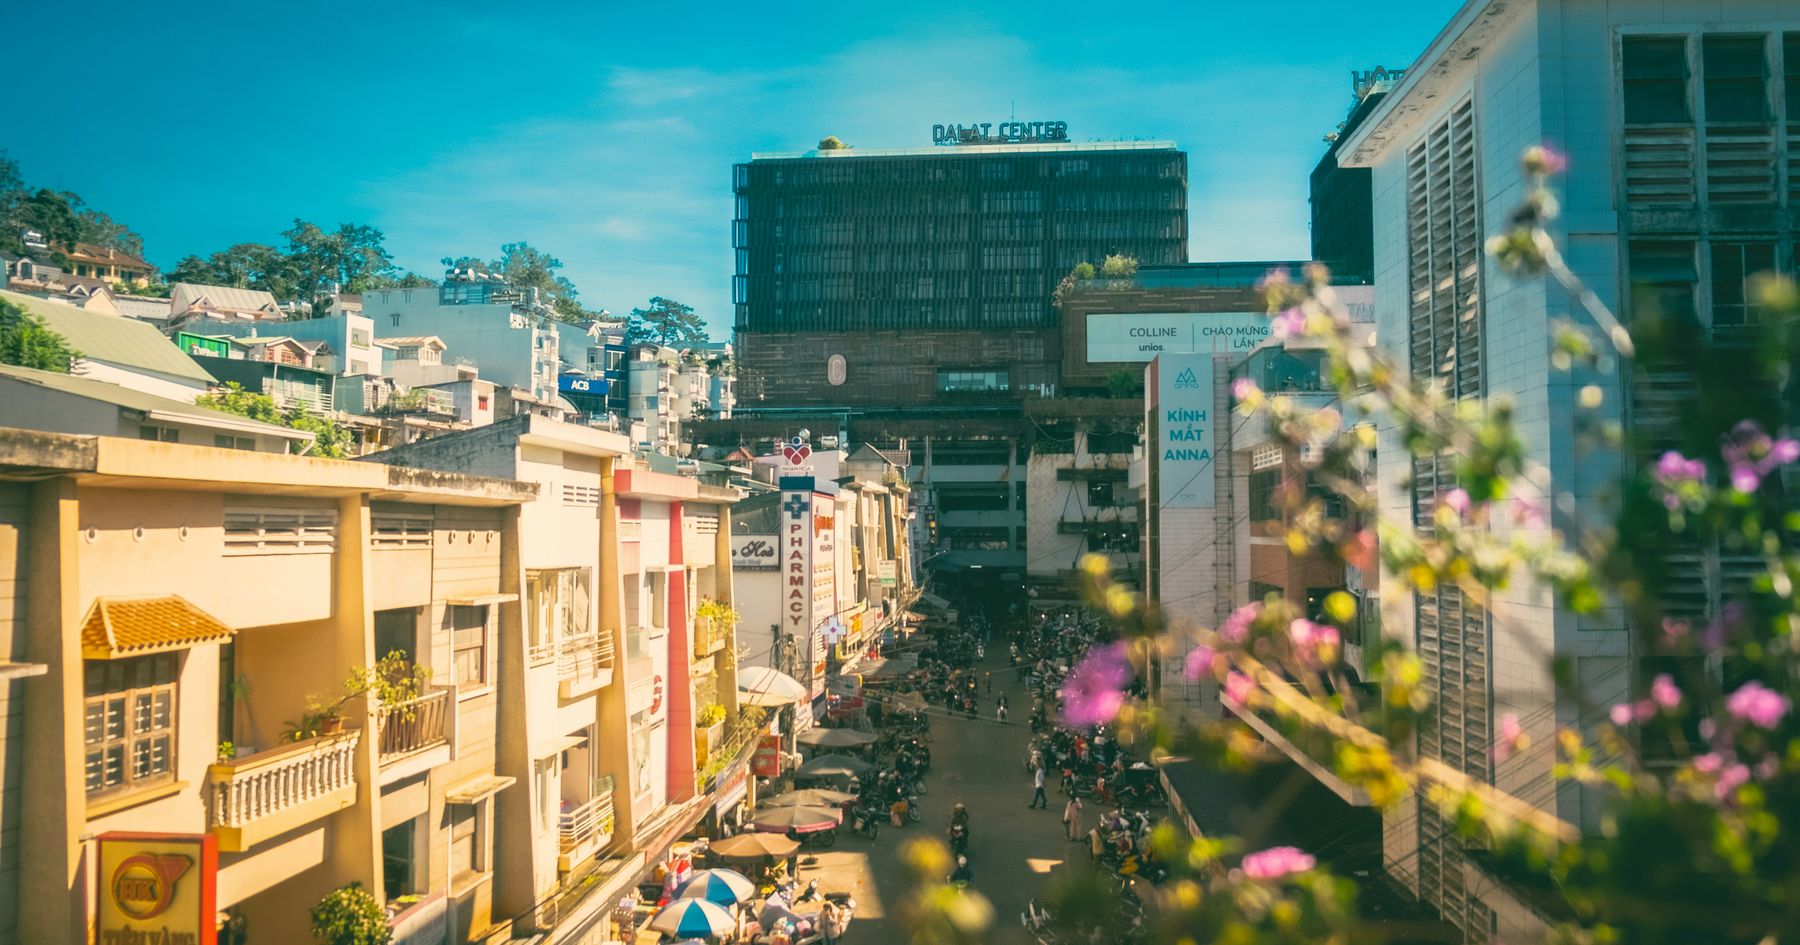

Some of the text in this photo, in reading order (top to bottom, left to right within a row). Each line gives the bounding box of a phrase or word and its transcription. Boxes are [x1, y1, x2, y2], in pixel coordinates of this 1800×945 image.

[932, 121, 1068, 142] DALAT CENTER
[1129, 327, 1177, 337] COLLINE
[1202, 325, 1234, 336] CHÀO
[1236, 324, 1268, 336] MỪNG
[1138, 343, 1164, 352] unios
[571, 380, 590, 391] ACB
[1167, 408, 1206, 422] KÍNH
[1169, 423, 1204, 441] MẮT
[1164, 449, 1211, 461] ANNA
[789, 524, 804, 626] PHARMACY
